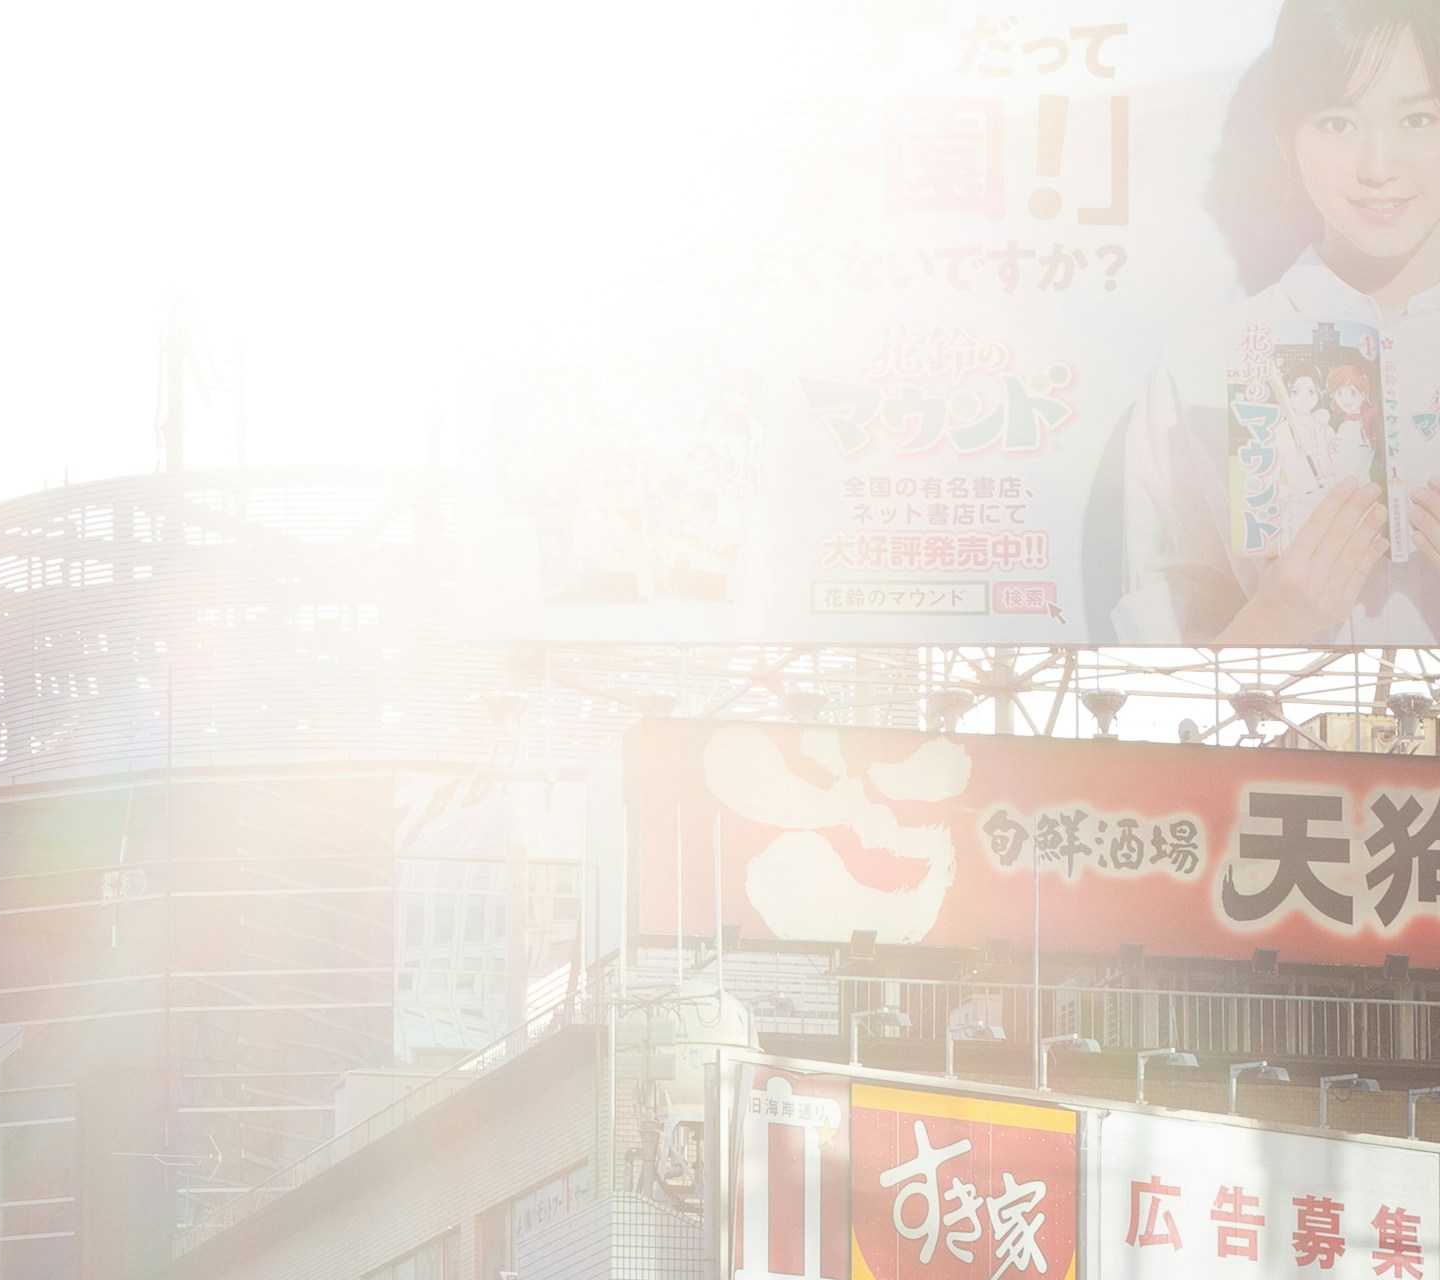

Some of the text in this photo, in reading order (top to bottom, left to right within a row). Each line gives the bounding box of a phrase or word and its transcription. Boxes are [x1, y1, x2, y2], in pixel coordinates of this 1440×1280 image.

[850, 500, 1027, 526] ネット書店にて
[1002, 586, 1047, 609] 検索
[981, 809, 1208, 880] 旬鮮酒場
